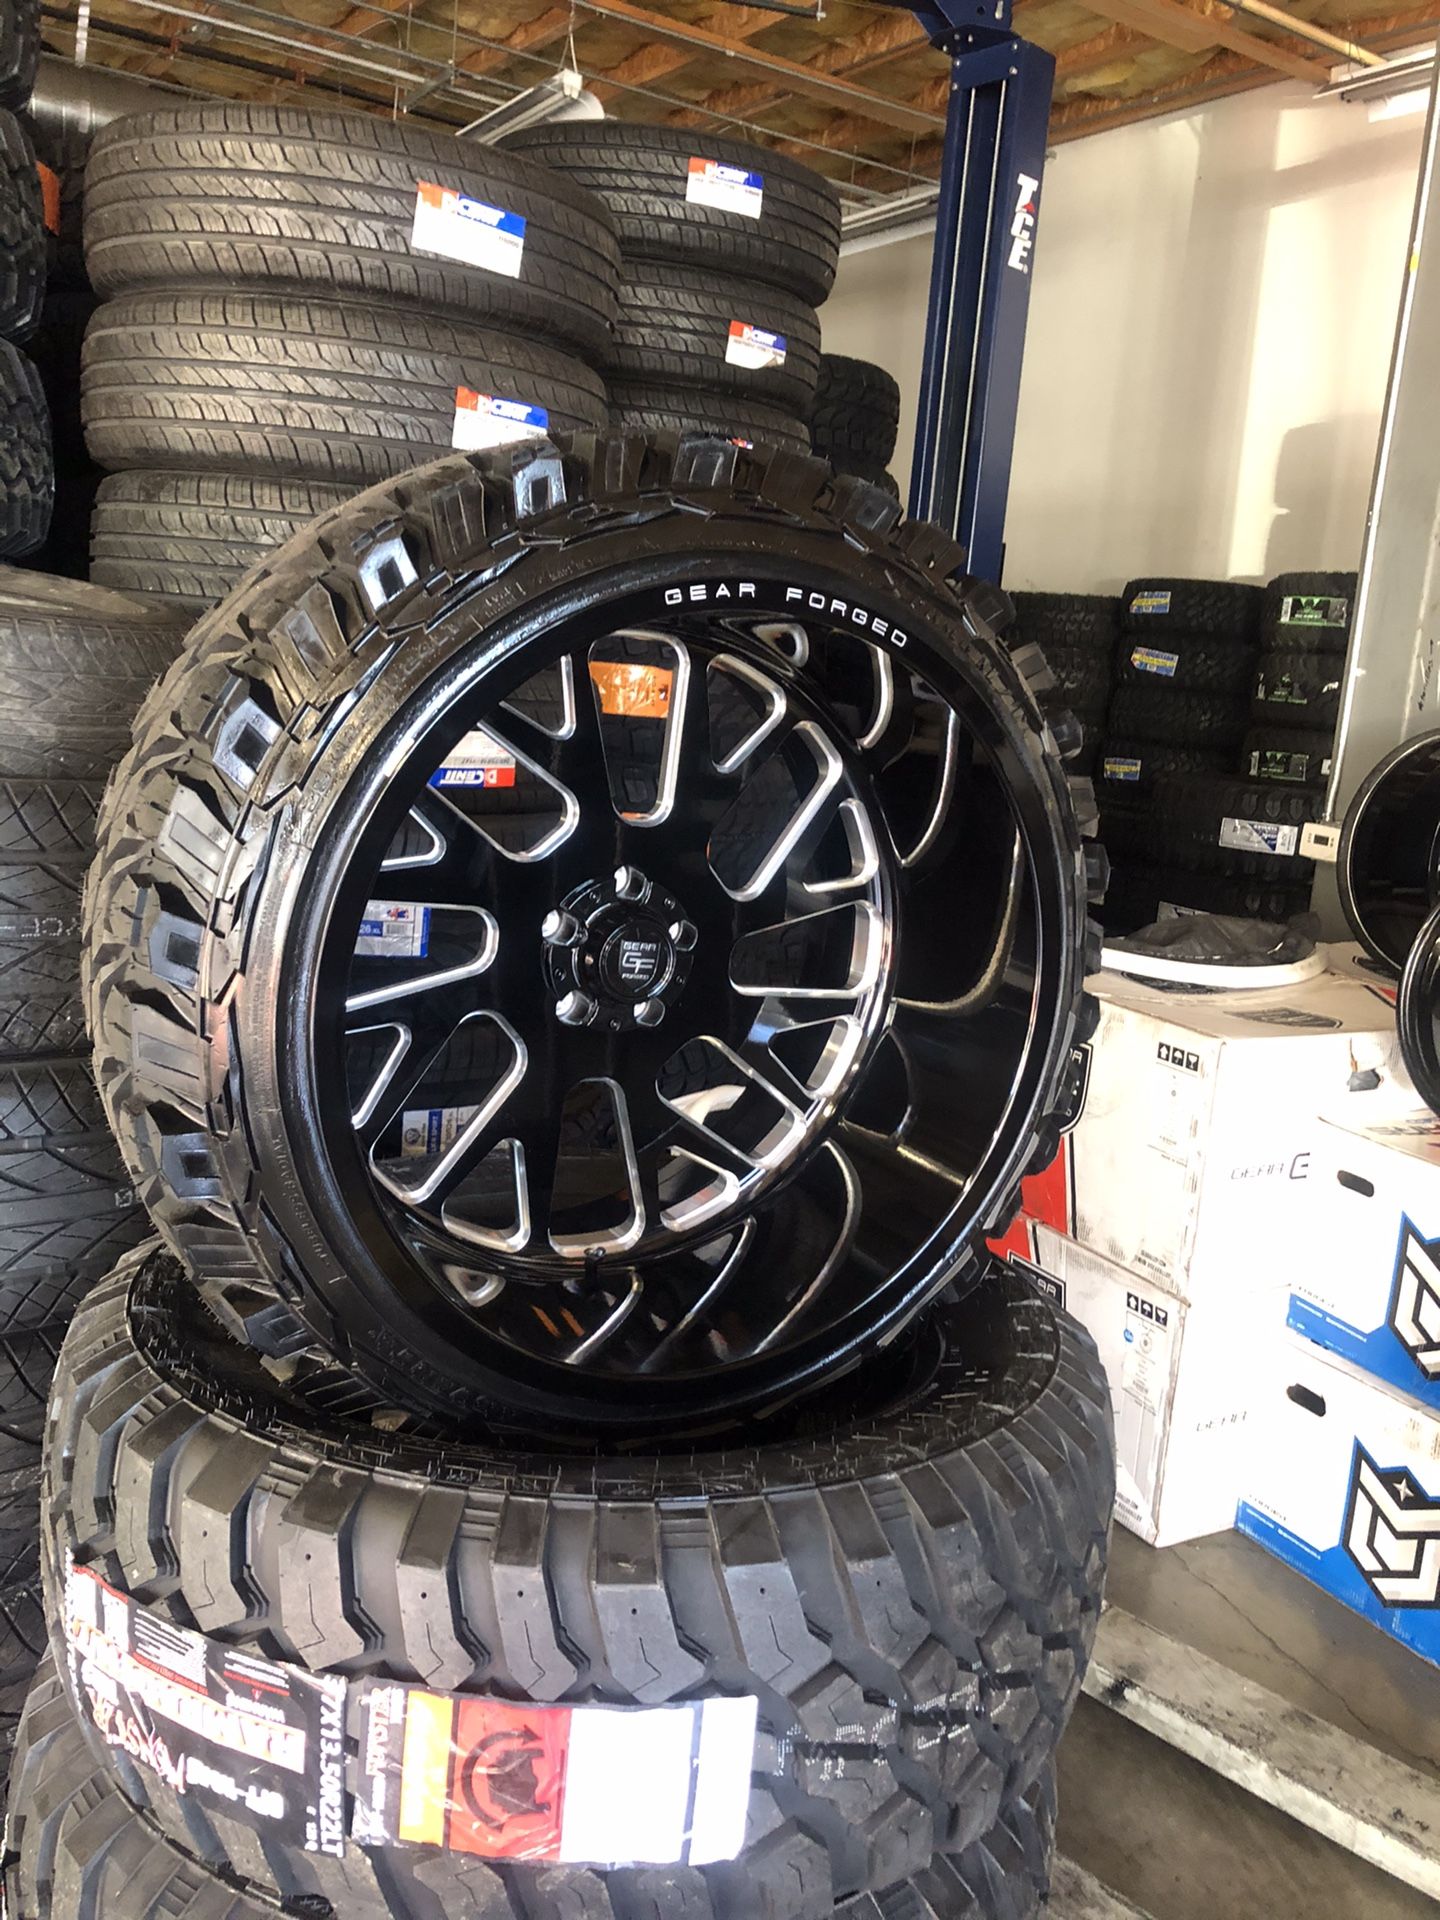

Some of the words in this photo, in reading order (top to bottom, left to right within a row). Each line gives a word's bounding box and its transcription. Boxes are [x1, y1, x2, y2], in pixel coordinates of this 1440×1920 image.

[664, 583, 756, 605] GEAR
[785, 587, 908, 648] FORGED
[623, 940, 657, 951] GEAR
